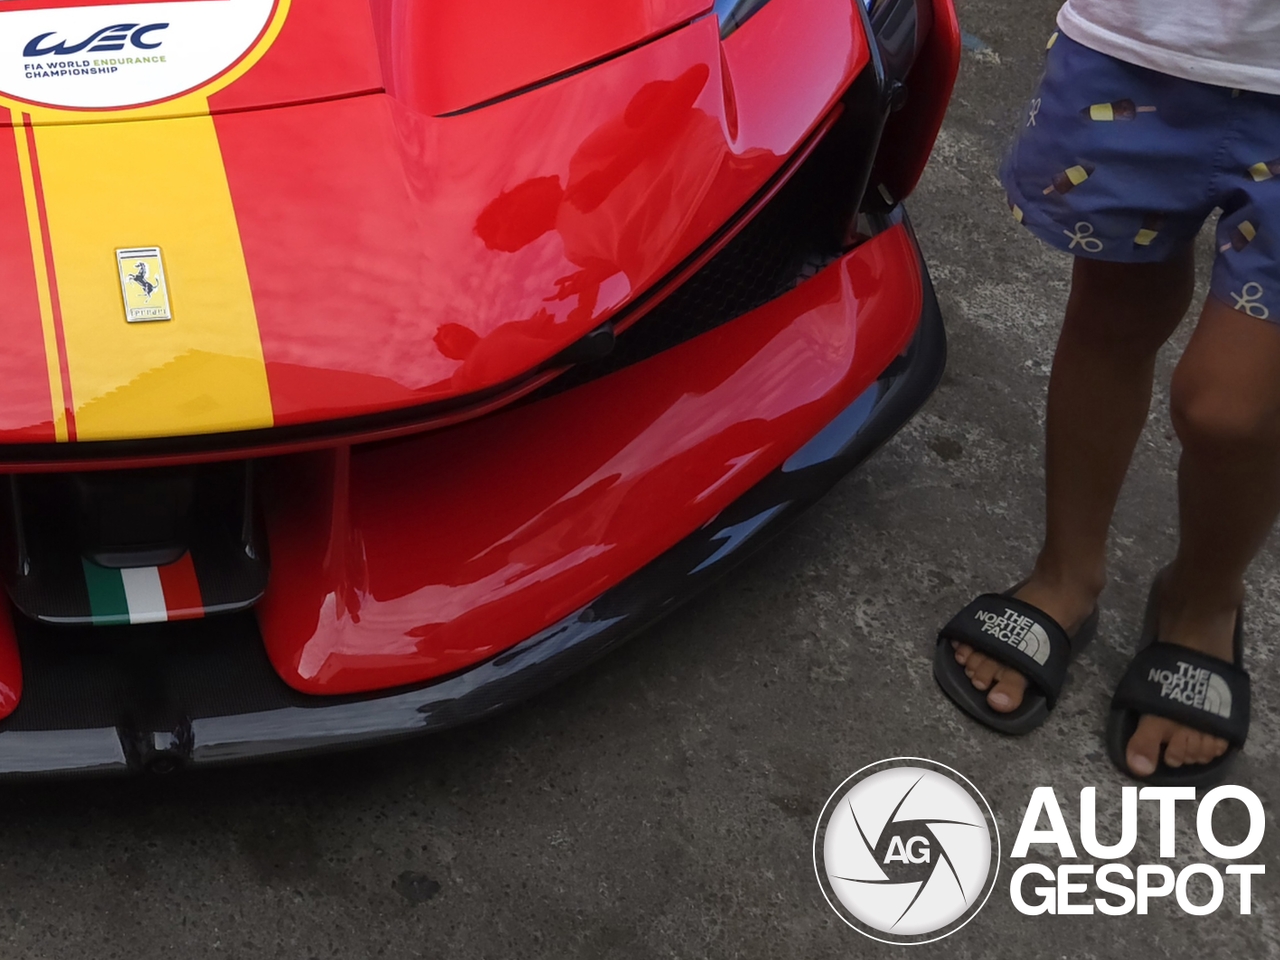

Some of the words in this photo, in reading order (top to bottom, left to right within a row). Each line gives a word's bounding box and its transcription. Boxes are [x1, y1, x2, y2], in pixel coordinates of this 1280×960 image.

[23, 23, 170, 57] WEC
[24, 62, 43, 71] FIA
[46, 60, 90, 69] WORLD
[93, 55, 167, 67] ENDURANCE
[25, 66, 118, 79] CHAMPIONSHIP
[974, 610, 1028, 638] NORTH
[1004, 608, 1034, 630] THE
[981, 622, 1021, 648] FACE
[1147, 667, 1209, 696] NORTH
[1176, 661, 1211, 681] THE
[1160, 685, 1204, 710] FACE
